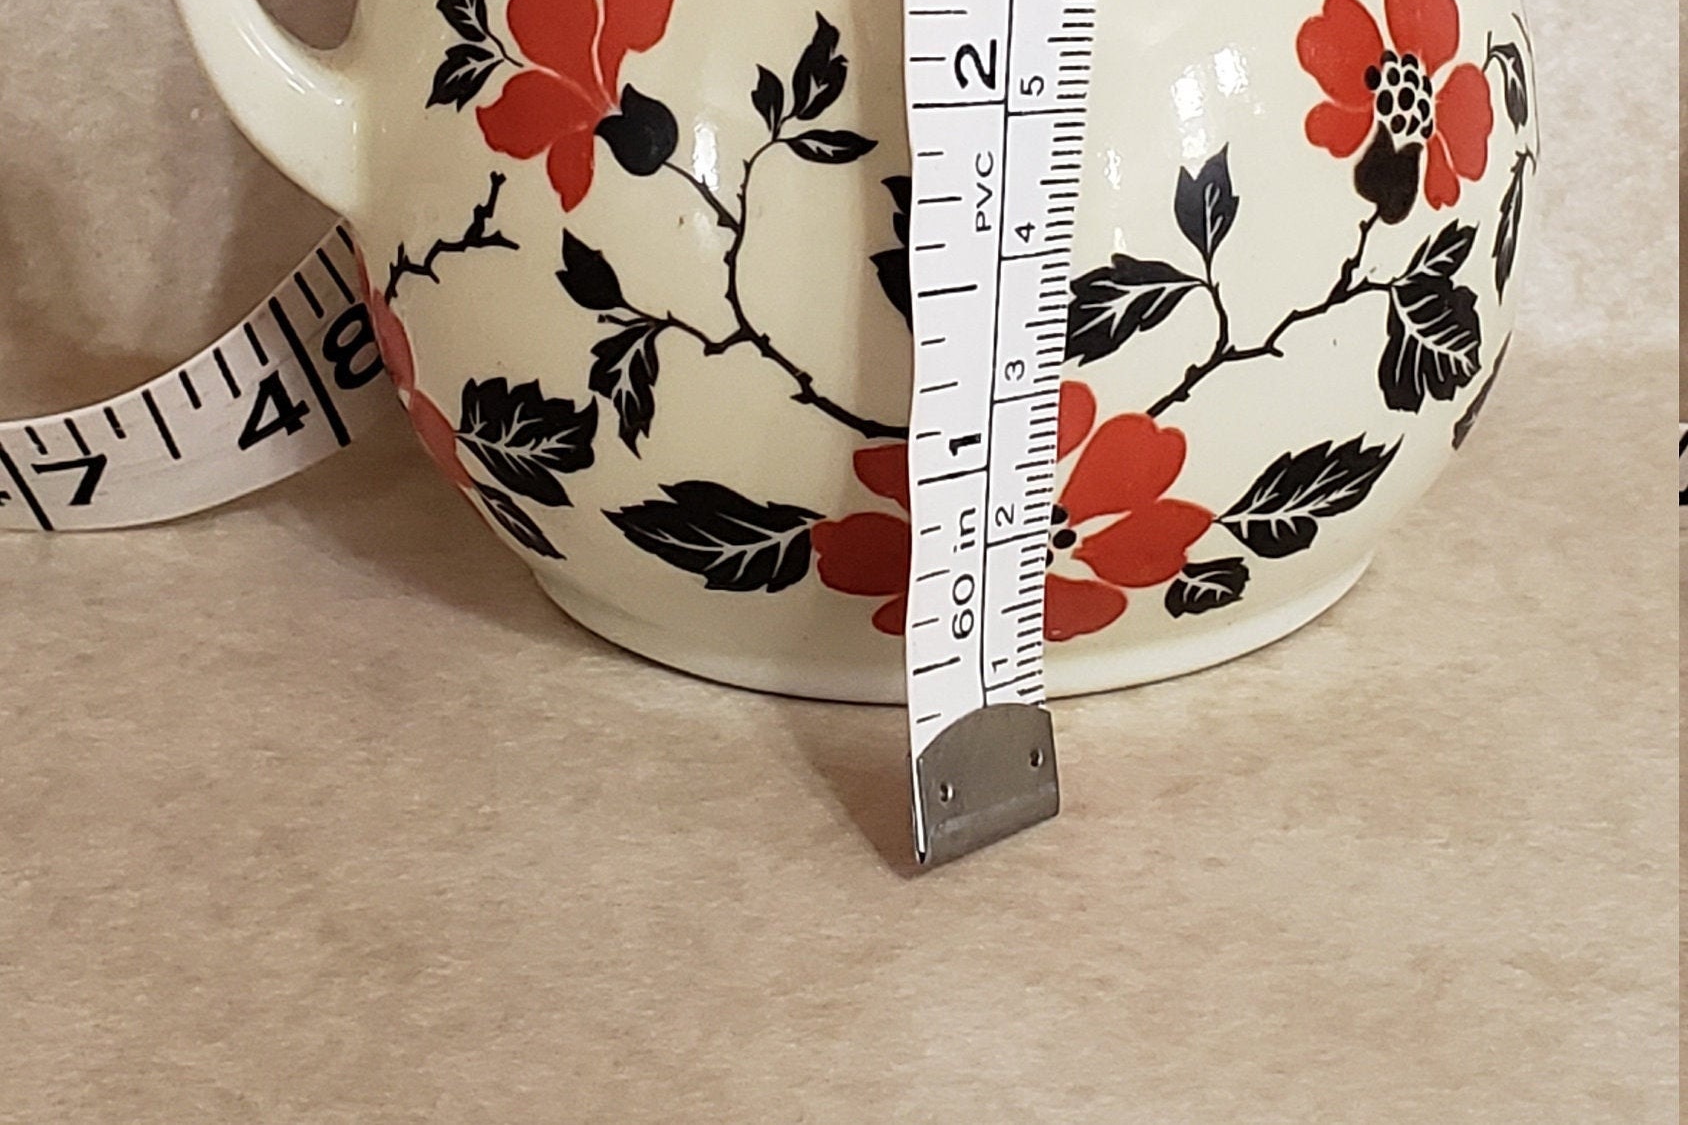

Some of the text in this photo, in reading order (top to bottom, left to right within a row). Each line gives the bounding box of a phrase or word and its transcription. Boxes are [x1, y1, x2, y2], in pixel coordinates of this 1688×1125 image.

[953, 38, 998, 90] 2
[1019, 74, 1045, 97] 5
[974, 150, 995, 233] PVC
[1014, 221, 1036, 244] 4
[1004, 358, 1025, 382] 3
[949, 432, 982, 457] 1
[994, 502, 1015, 528] 2
[951, 507, 976, 640] 60 in
[991, 658, 1009, 673] 1
